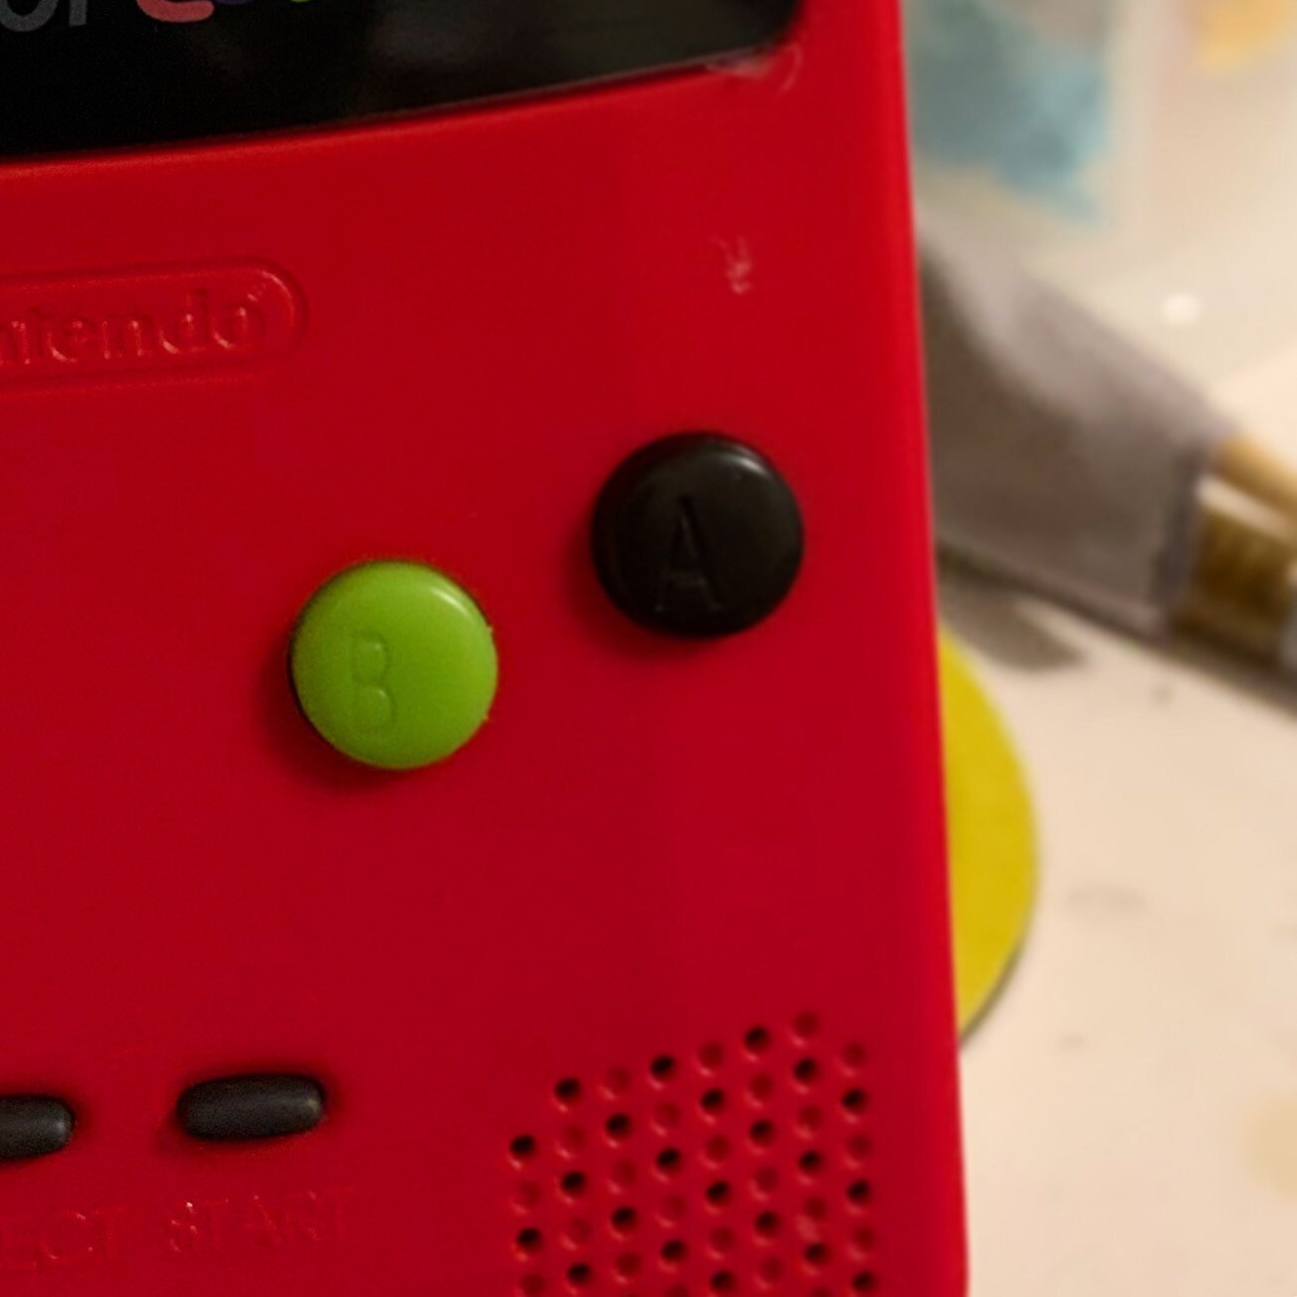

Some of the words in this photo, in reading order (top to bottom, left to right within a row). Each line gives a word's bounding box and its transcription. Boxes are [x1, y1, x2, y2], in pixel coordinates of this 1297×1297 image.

[652, 495, 723, 612] A
[350, 630, 398, 733] B
[169, 1186, 354, 1253] START
